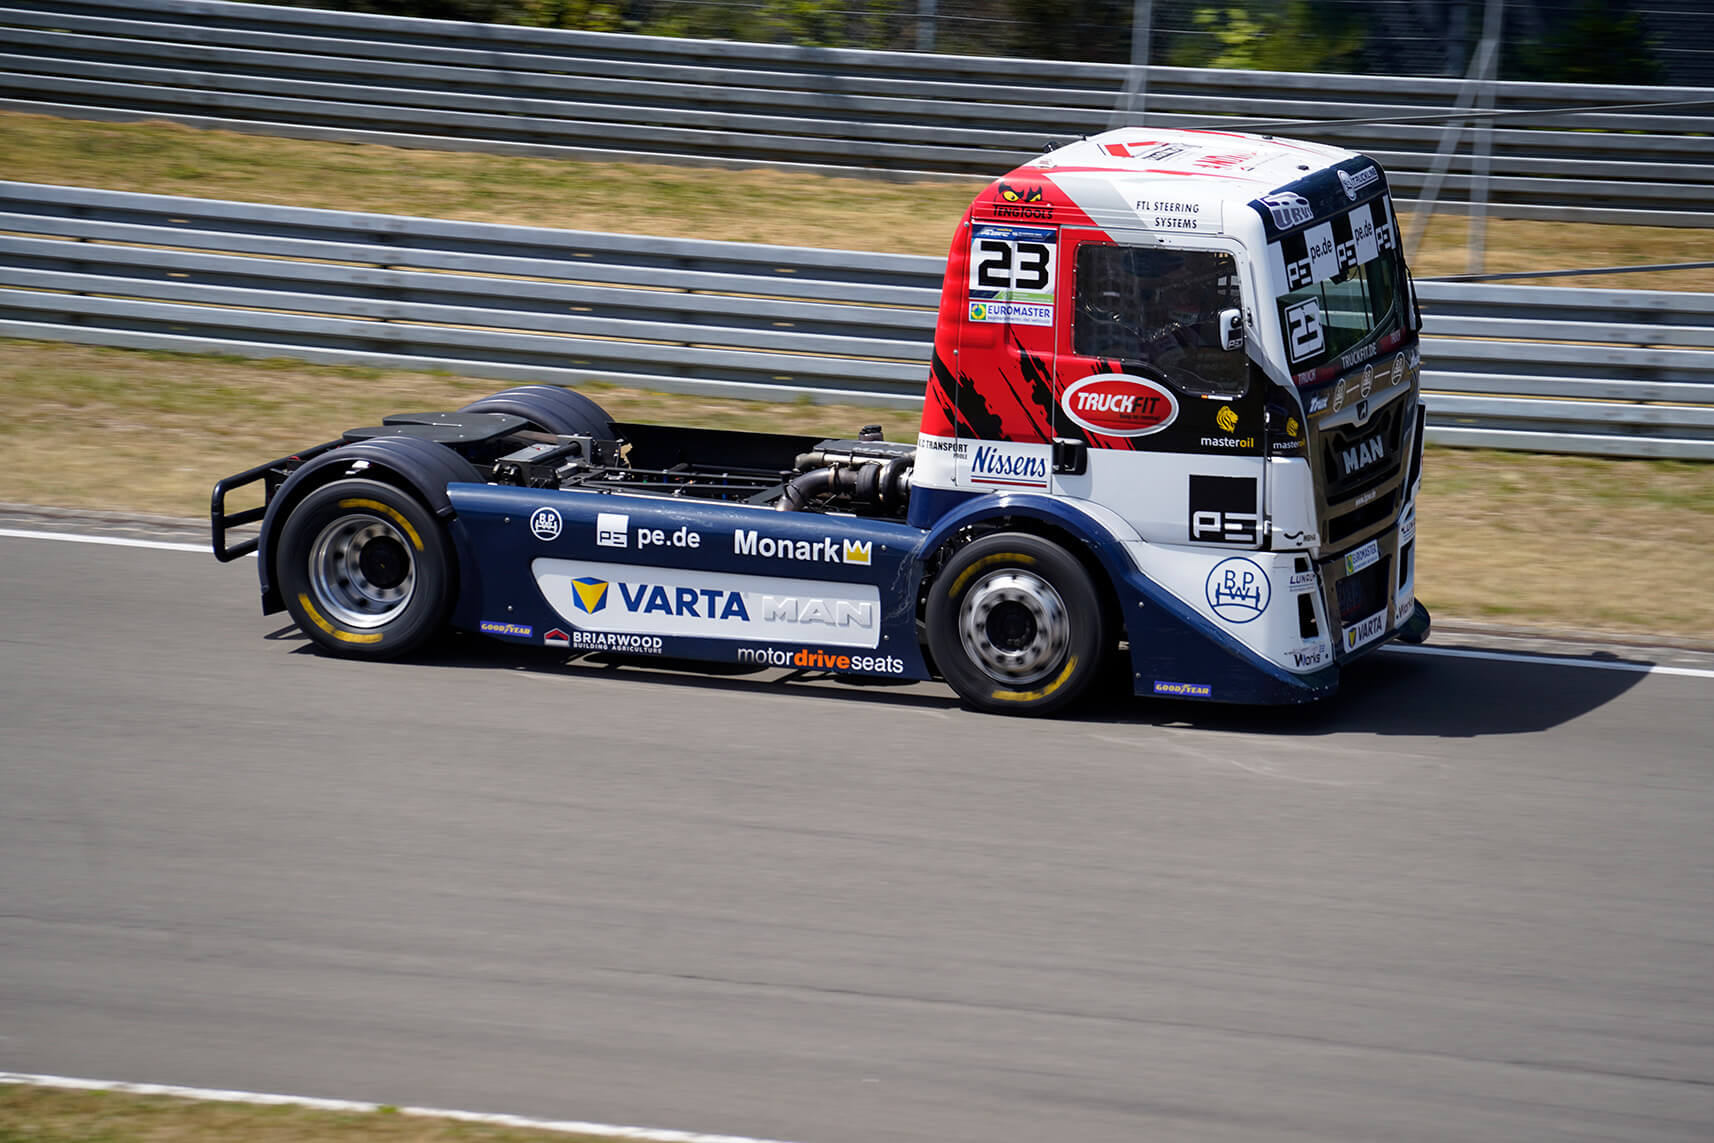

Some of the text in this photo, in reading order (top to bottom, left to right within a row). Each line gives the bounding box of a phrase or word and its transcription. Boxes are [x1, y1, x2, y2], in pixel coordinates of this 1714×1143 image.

[1136, 200, 1200, 213] FTL STEERING
[1154, 217, 1198, 229] SYSTEMS
[1354, 220, 1373, 244] pe.de
[1310, 237, 1333, 264] pe.de
[978, 240, 1049, 290] 23
[988, 305, 1050, 318] EUROMASTER
[1288, 300, 1324, 359] 23
[1077, 392, 1160, 414] TRUCKFIT
[926, 440, 969, 453] TRANSPORT
[1200, 437, 1254, 448] masteroil
[971, 446, 1047, 478] Nissens
[1342, 435, 1384, 475] MAN
[637, 526, 700, 549] pe.de
[734, 529, 841, 563] Monark
[618, 582, 751, 622] VARTA
[762, 595, 873, 629] MAN
[481, 623, 531, 635] GOODYEAR
[1358, 615, 1382, 640] VARTA
[573, 632, 662, 648] BRIARWOOD
[573, 642, 663, 654] BUILDING AGRICULTURE
[1155, 683, 1209, 695] GOODYEAR
